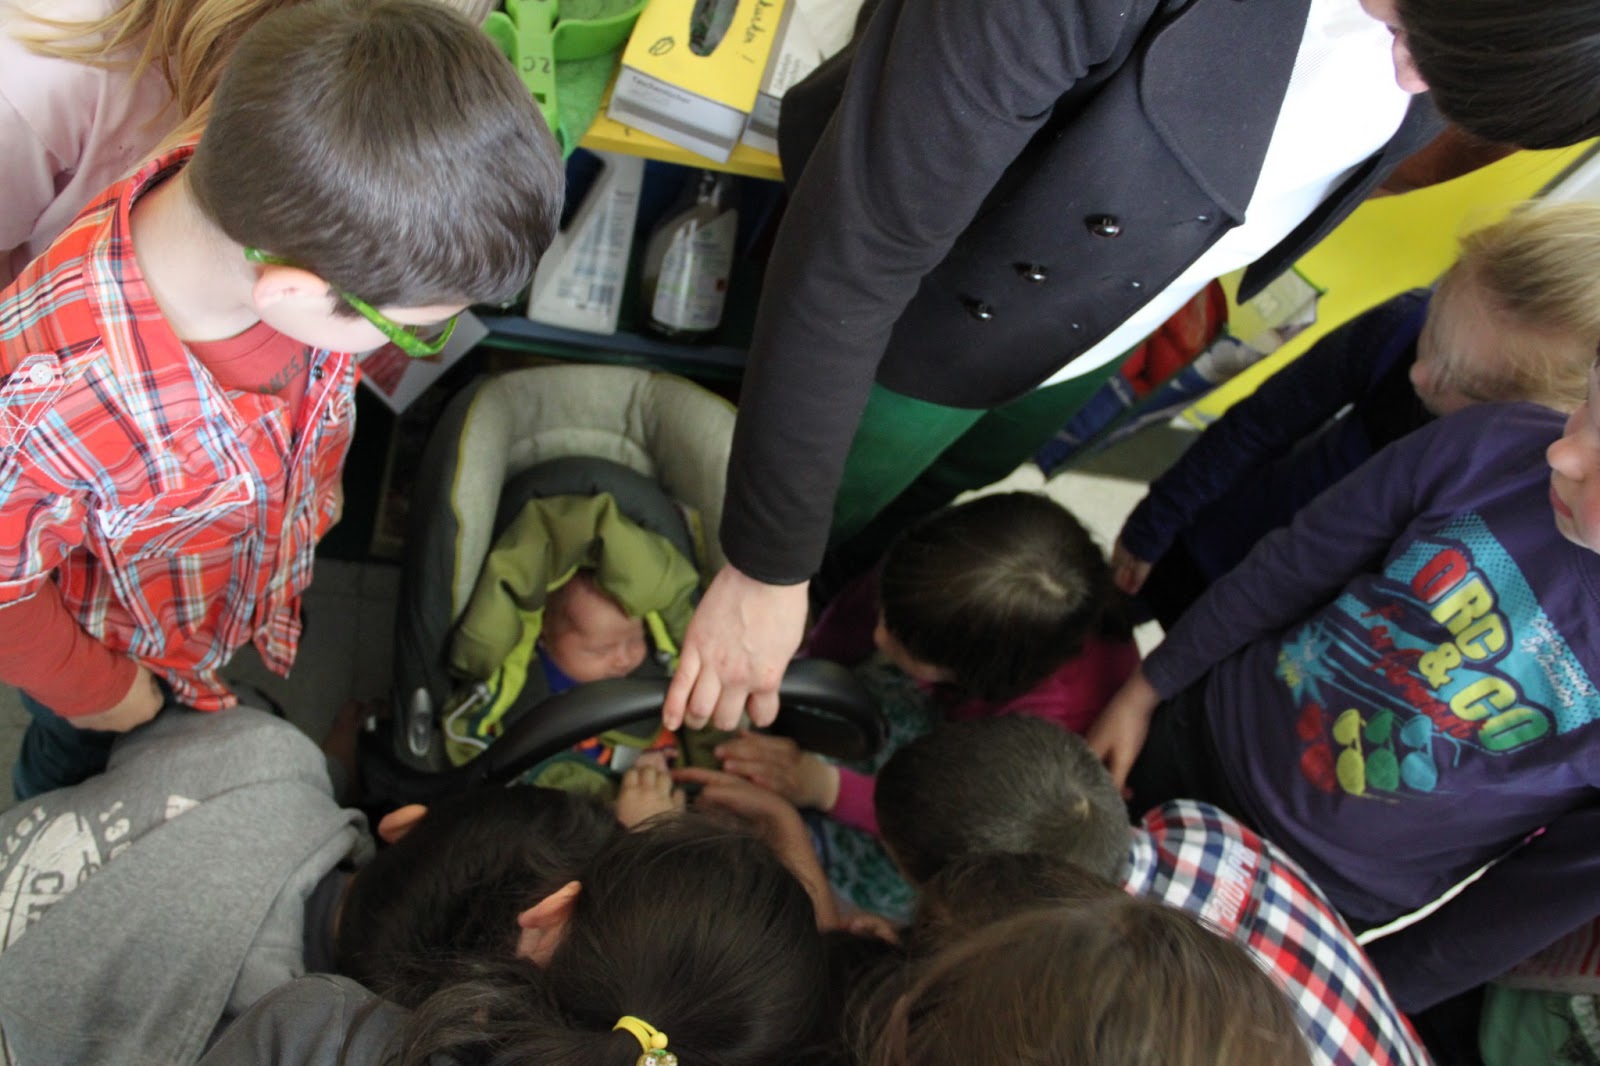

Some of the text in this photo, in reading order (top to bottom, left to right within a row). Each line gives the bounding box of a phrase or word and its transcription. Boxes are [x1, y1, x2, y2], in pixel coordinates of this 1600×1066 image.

[1411, 548, 1506, 661] ORC
[1418, 642, 1463, 689] &
[1450, 676, 1549, 751] CO
